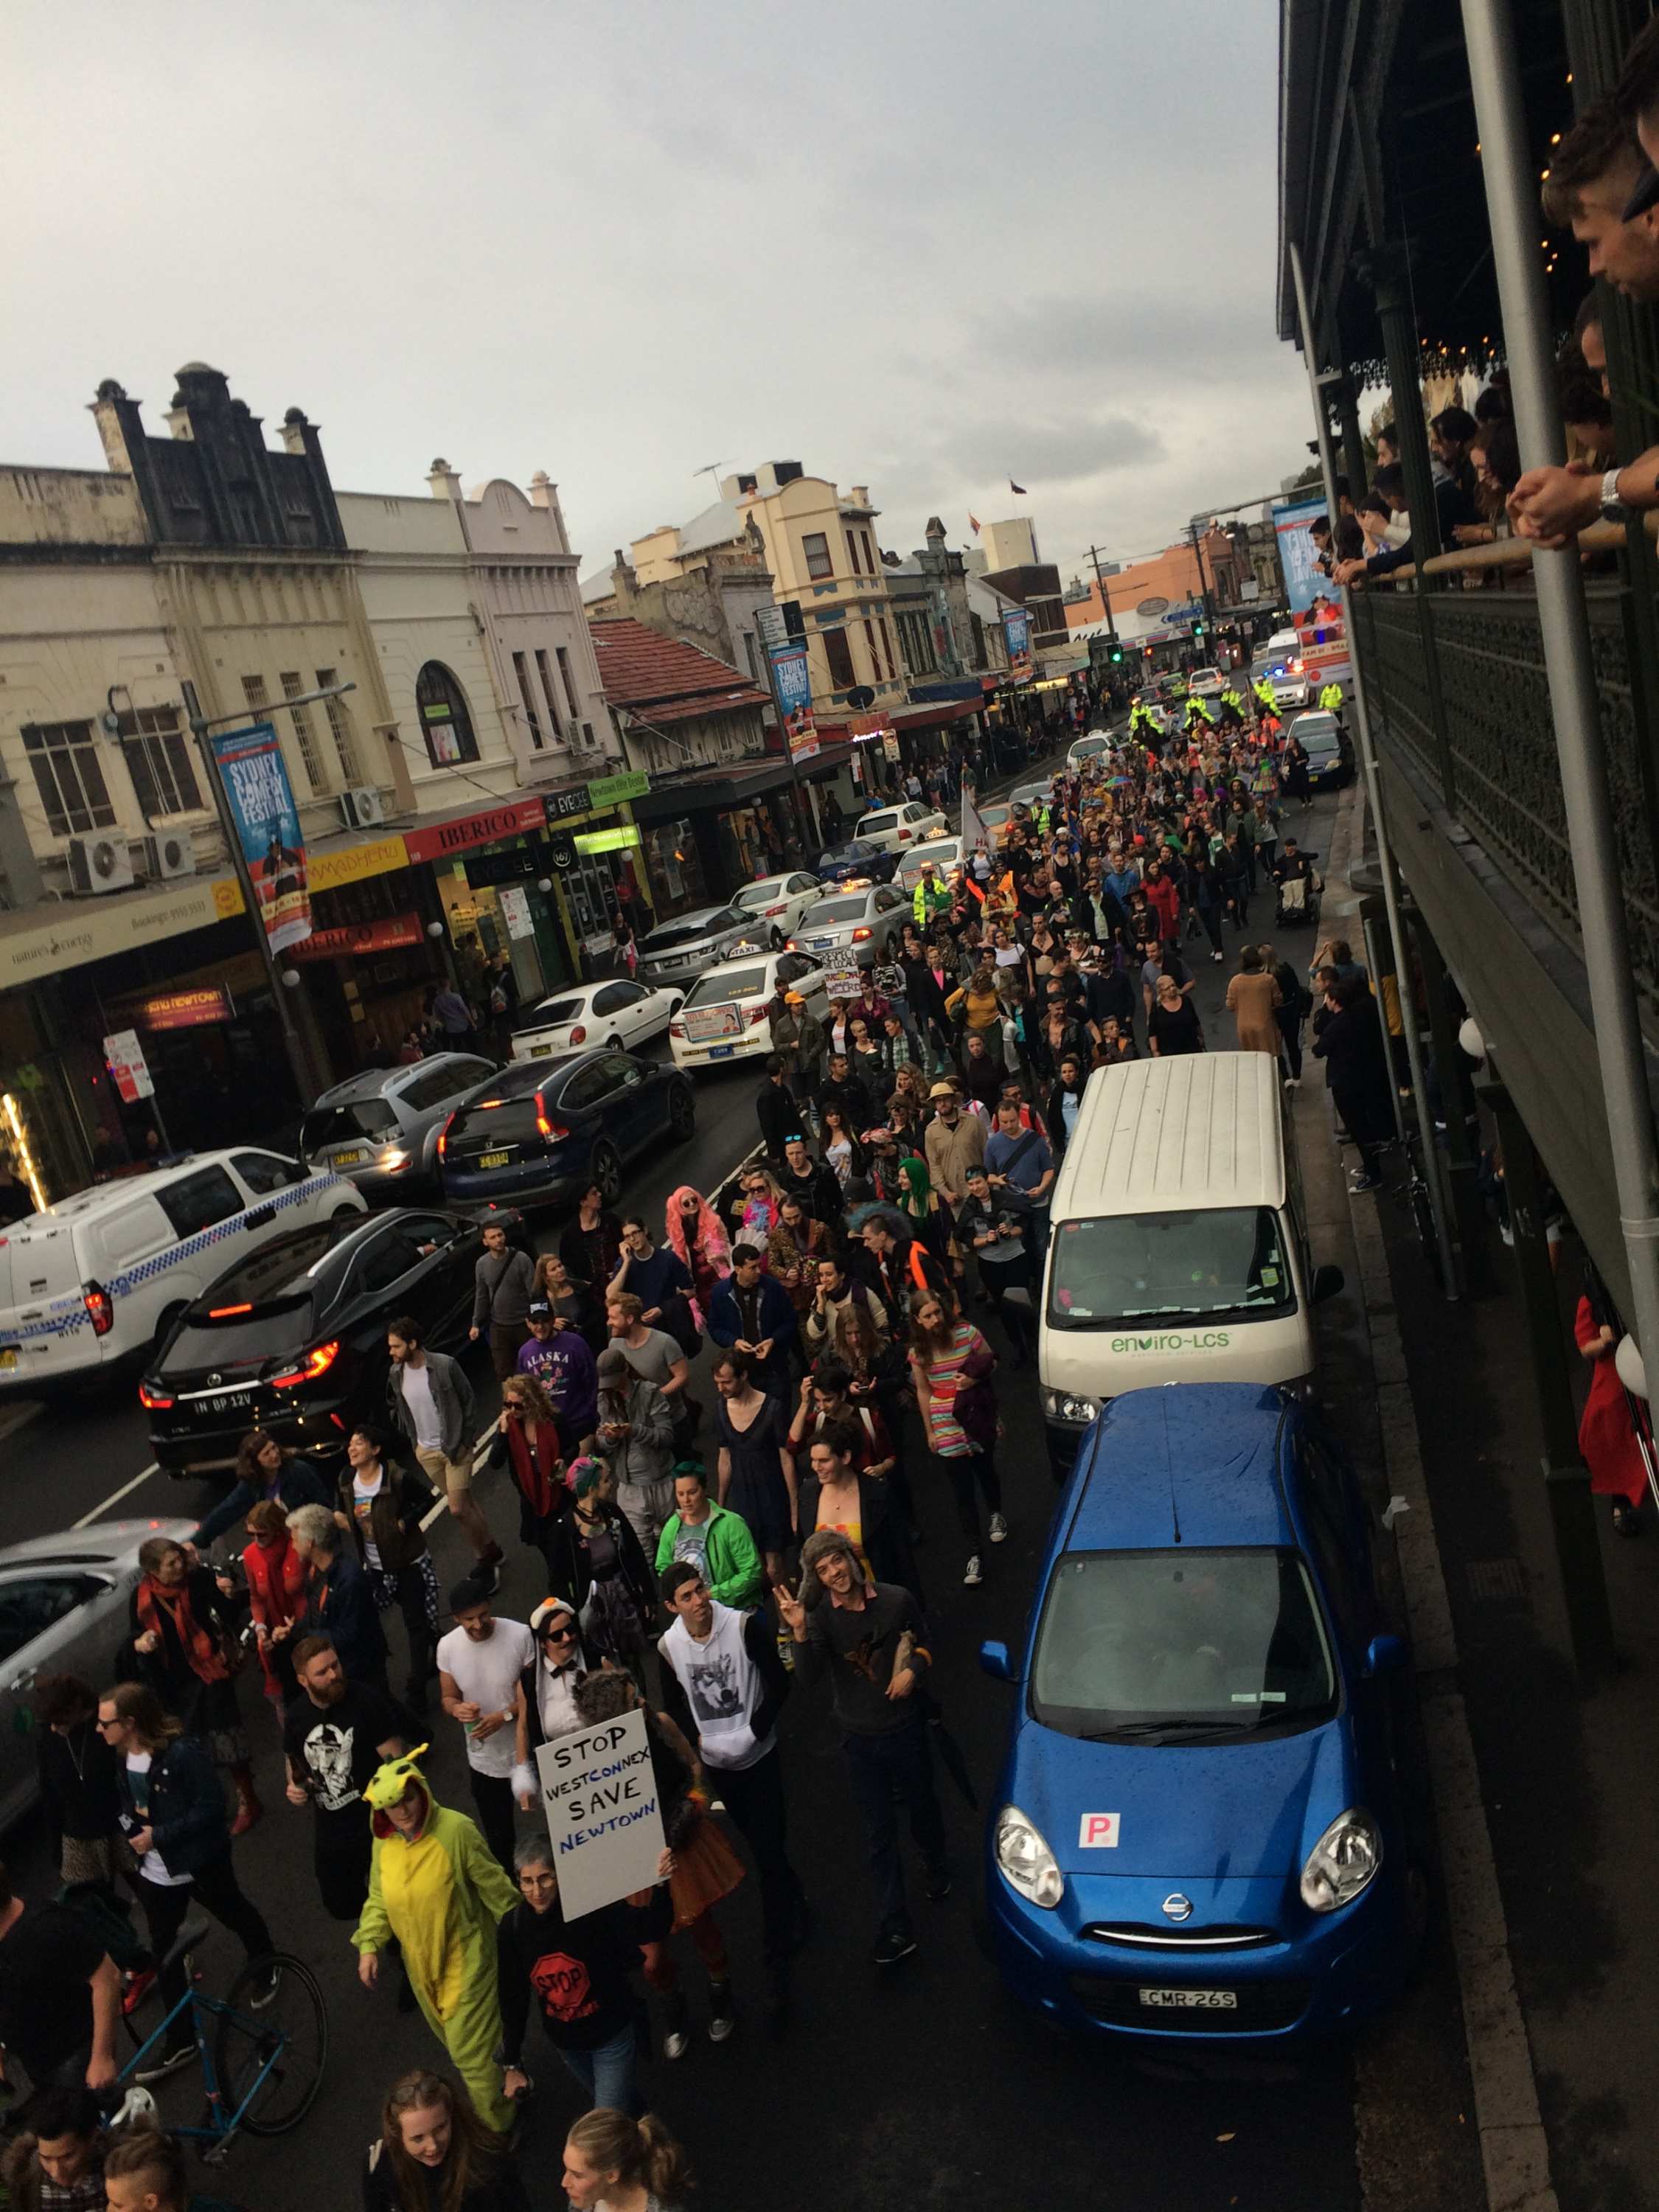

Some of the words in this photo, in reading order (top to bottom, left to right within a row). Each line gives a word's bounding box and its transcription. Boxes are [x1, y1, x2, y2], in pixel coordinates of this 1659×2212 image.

[777, 658, 805, 677] SYDNEY
[229, 752, 279, 787] SYDNEY
[234, 774, 285, 807] COMEDY
[590, 783, 616, 798] Newtown
[439, 812, 518, 850] IBERICO
[554, 852, 568, 864] 167
[290, 926, 374, 958] IBERICO
[734, 947, 754, 956] TAXI
[526, 1351, 570, 1370] ALASKA
[554, 1727, 626, 1768] STOP
[546, 1746, 651, 1801] WESTCONNEX
[568, 1777, 641, 1820] SAVE
[560, 1798, 655, 1854] NEWTOWN
[1088, 1817, 1110, 1843] P
[537, 1967, 581, 1993] STOP
